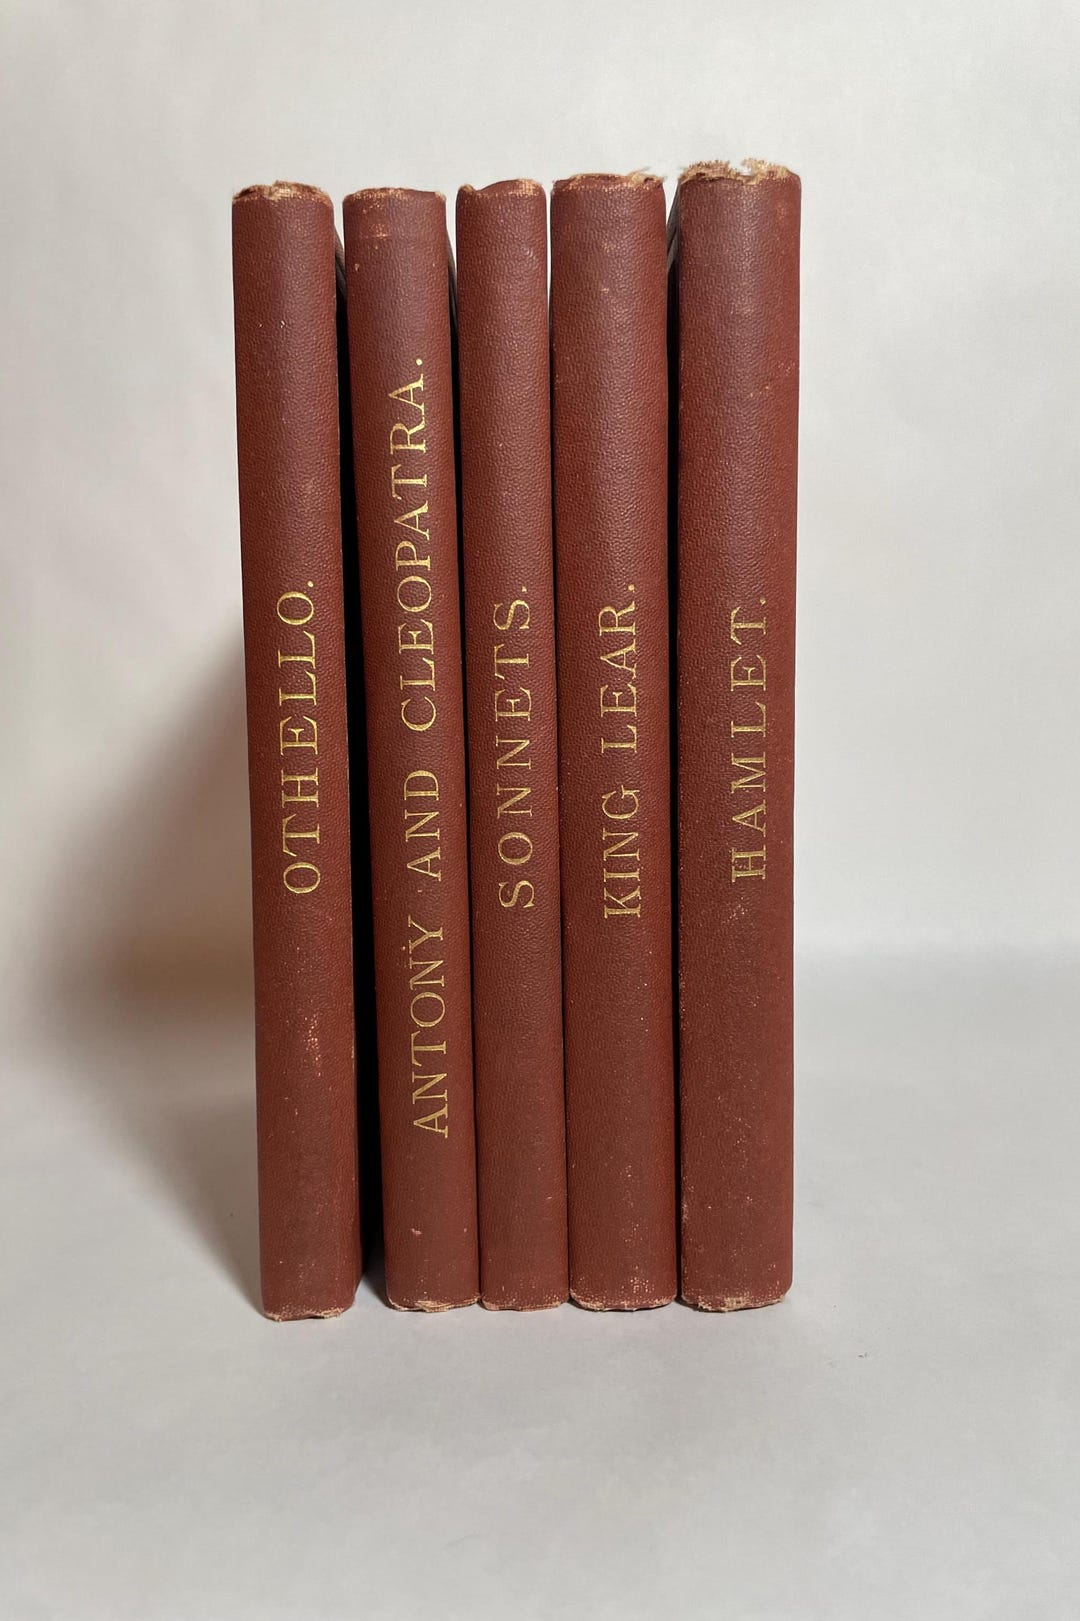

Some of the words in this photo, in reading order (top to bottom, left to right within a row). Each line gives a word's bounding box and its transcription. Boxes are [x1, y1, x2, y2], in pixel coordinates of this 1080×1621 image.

[389, 357, 437, 732] CLEOPATRA.
[598, 583, 638, 754] LEAR.
[277, 580, 321, 895] OTHELLO.
[404, 769, 441, 881] AND
[493, 585, 535, 909] SONNETS.
[602, 784, 642, 919] KING
[730, 597, 767, 882] HAMLET.
[408, 914, 448, 1139] ANTONY
